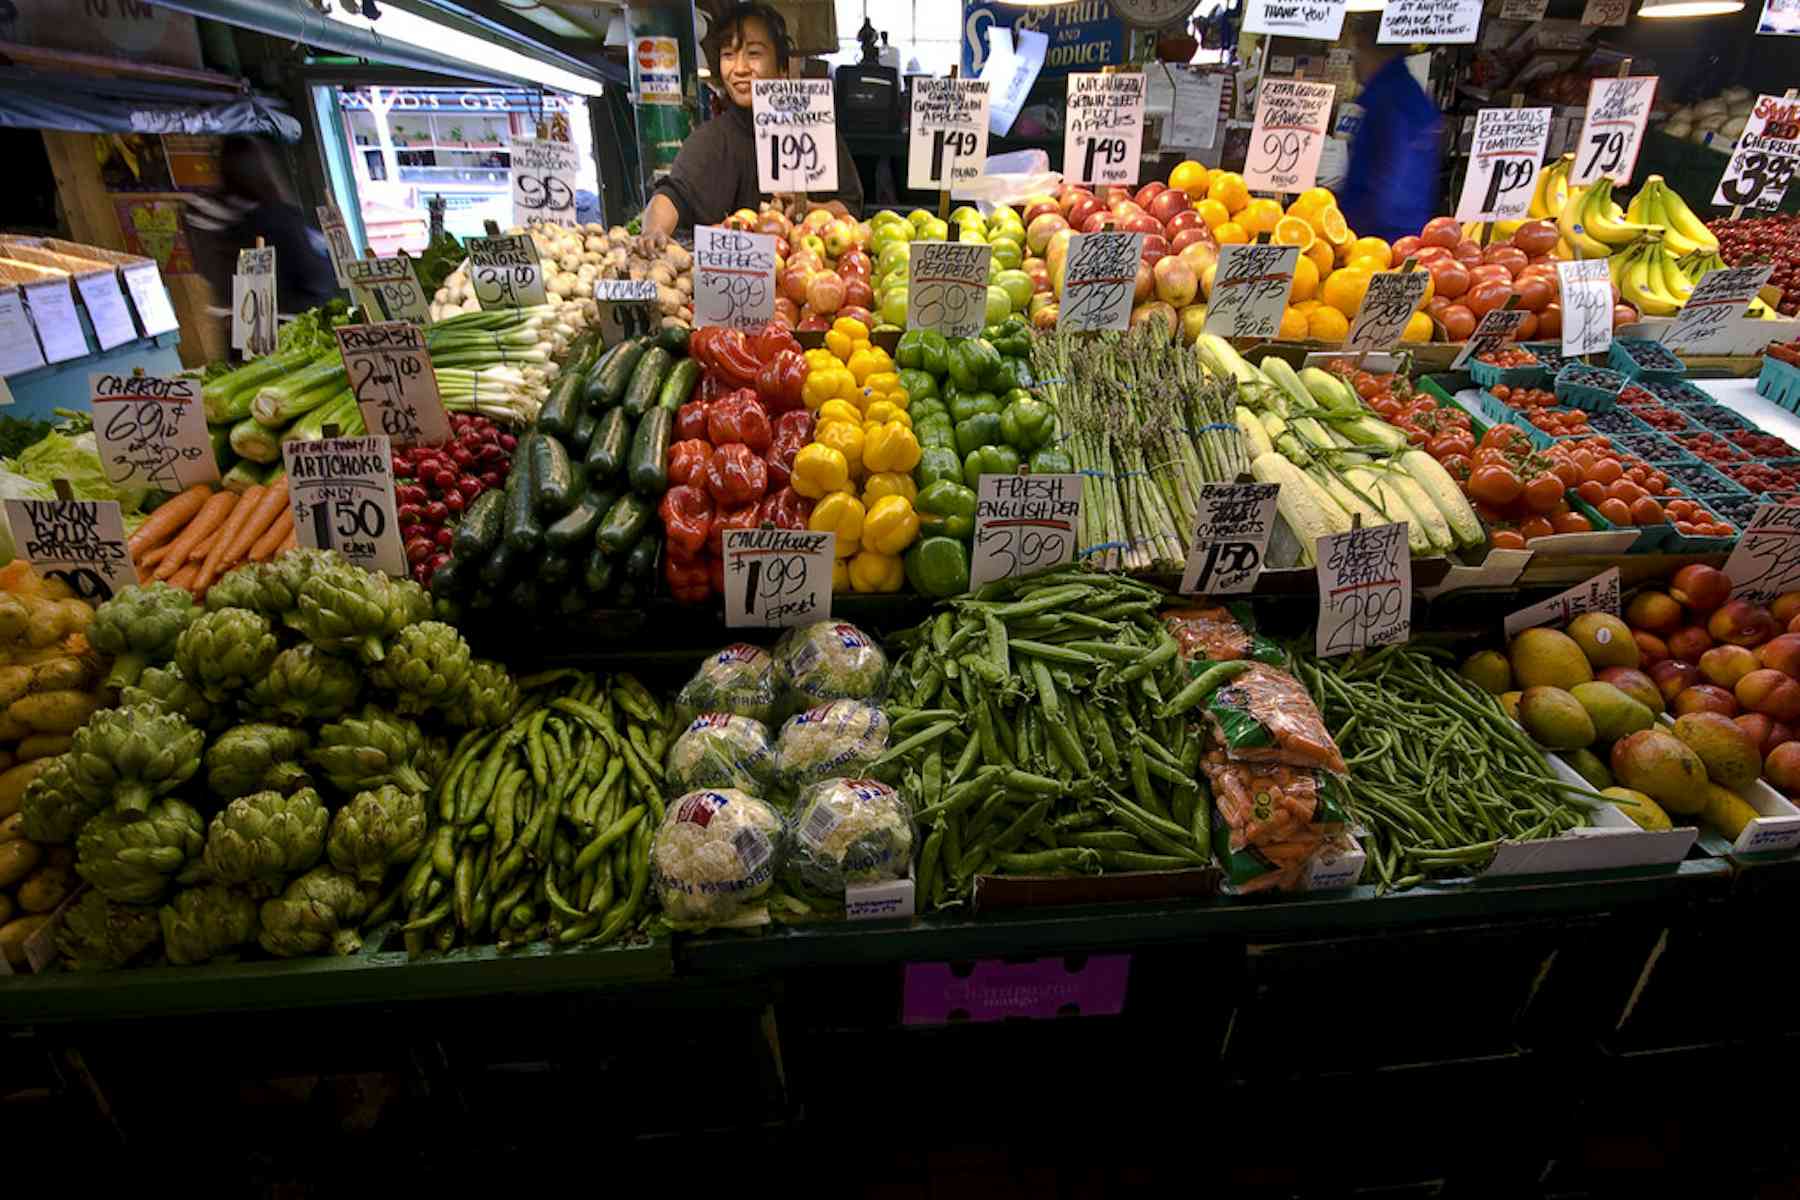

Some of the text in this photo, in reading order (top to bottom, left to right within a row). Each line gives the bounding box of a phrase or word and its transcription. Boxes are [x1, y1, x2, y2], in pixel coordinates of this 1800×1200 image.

[1053, 1, 1111, 26] FRUIT
[1264, 5, 1331, 23] THANK YOU!
[1433, 13, 1455, 24] THE
[1057, 29, 1081, 41] AND
[756, 110, 835, 127] GALA APPLES
[922, 111, 973, 123] APPLES
[1072, 115, 1136, 132] APPLES
[1480, 110, 1544, 125] DELICIOUS
[1478, 136, 1539, 152] TOMATOES
[951, 167, 979, 179] POUND
[470, 236, 525, 252] GREEN
[710, 231, 753, 251] RED
[472, 252, 530, 267] ONIONS
[697, 250, 774, 271] PEPPERS
[924, 243, 984, 263] GREEN
[1231, 244, 1299, 263] SWEET
[914, 258, 985, 283] PEPPERS
[340, 328, 417, 350] RADISH
[96, 375, 194, 398] CARROTS
[317, 487, 355, 499] ONLY
[991, 476, 1065, 501] FRESH
[22, 500, 99, 525] YUKON
[976, 500, 1080, 520] ENGLISH PEA
[33, 521, 100, 543] GOLDS
[1197, 521, 1265, 538] CARROTS
[1331, 524, 1402, 553] FRESH
[26, 540, 126, 560] POTATOES
[342, 542, 377, 554] EACH
[1327, 545, 1401, 571] GREEN
[1337, 562, 1399, 587] BEANS
[1371, 619, 1410, 641] POUND
